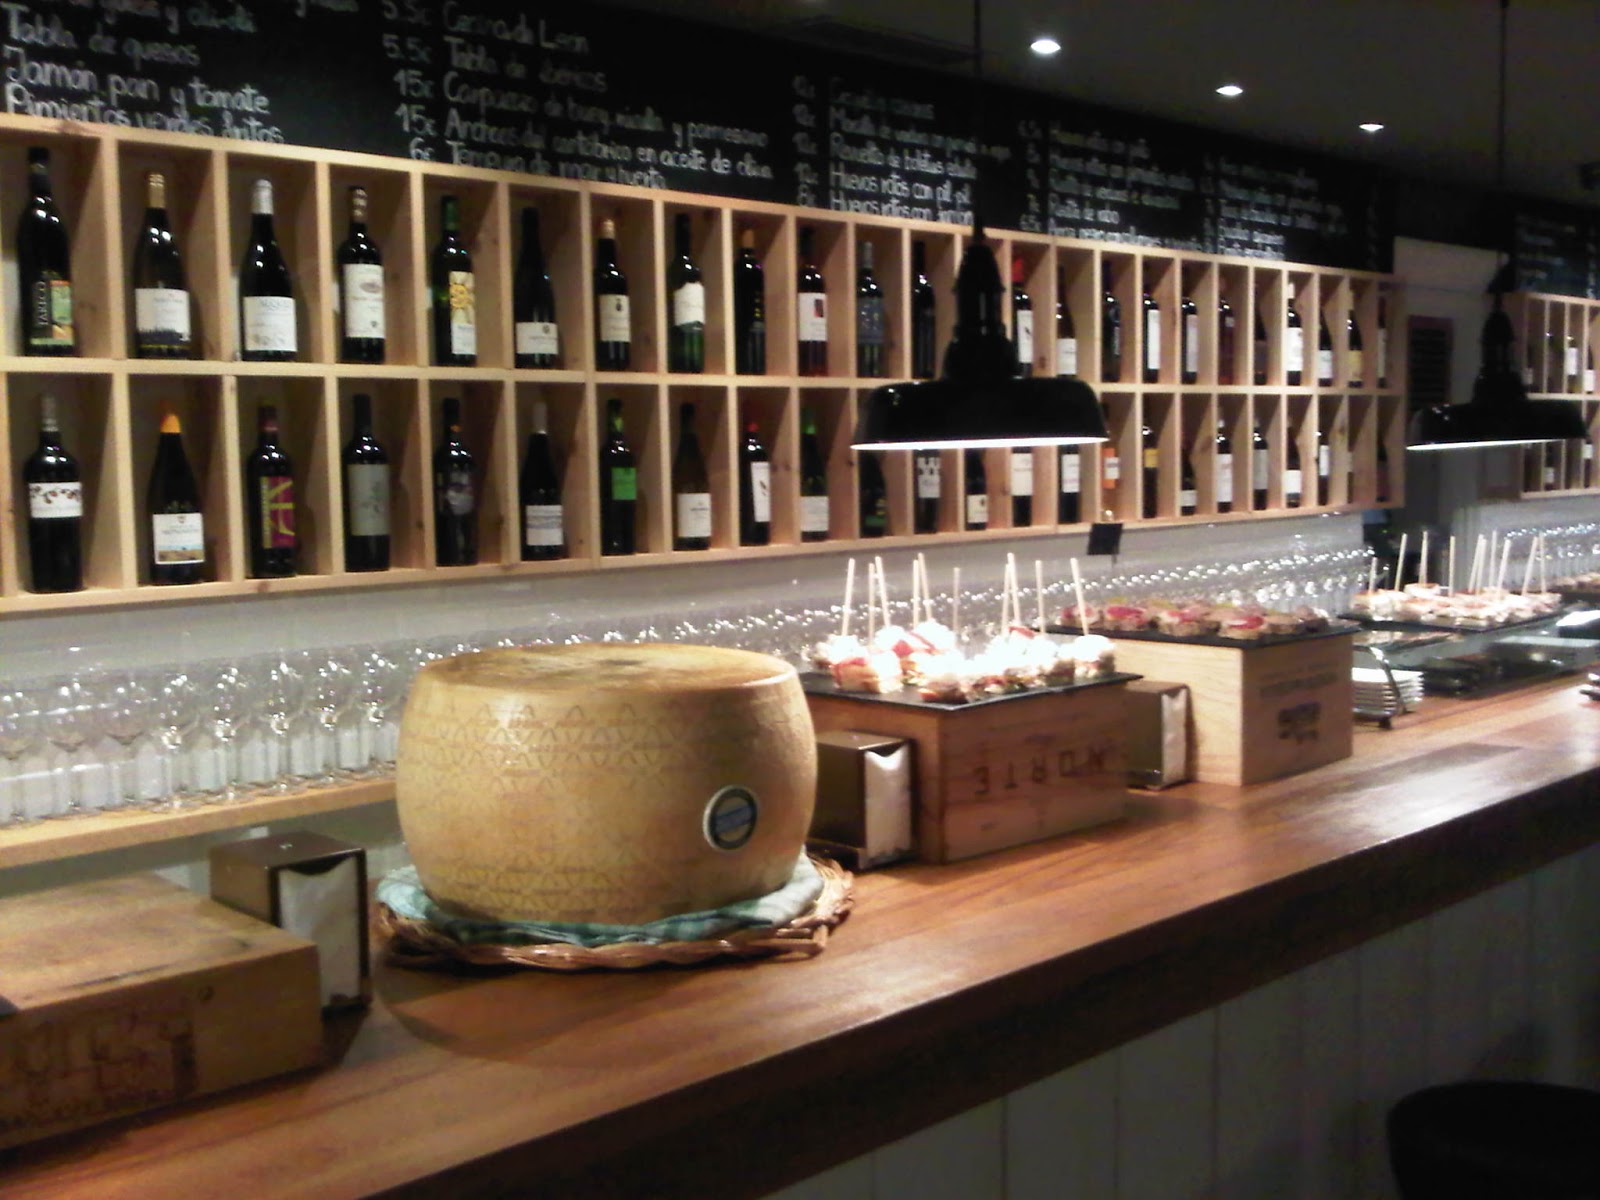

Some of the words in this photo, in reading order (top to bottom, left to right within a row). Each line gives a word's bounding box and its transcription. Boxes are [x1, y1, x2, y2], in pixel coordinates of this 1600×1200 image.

[0, 1, 78, 48] Tabla
[107, 74, 160, 108] pan
[188, 76, 271, 115] tomate
[635, 146, 658, 166] en
[659, 149, 708, 172] aceite
[710, 147, 733, 174] de
